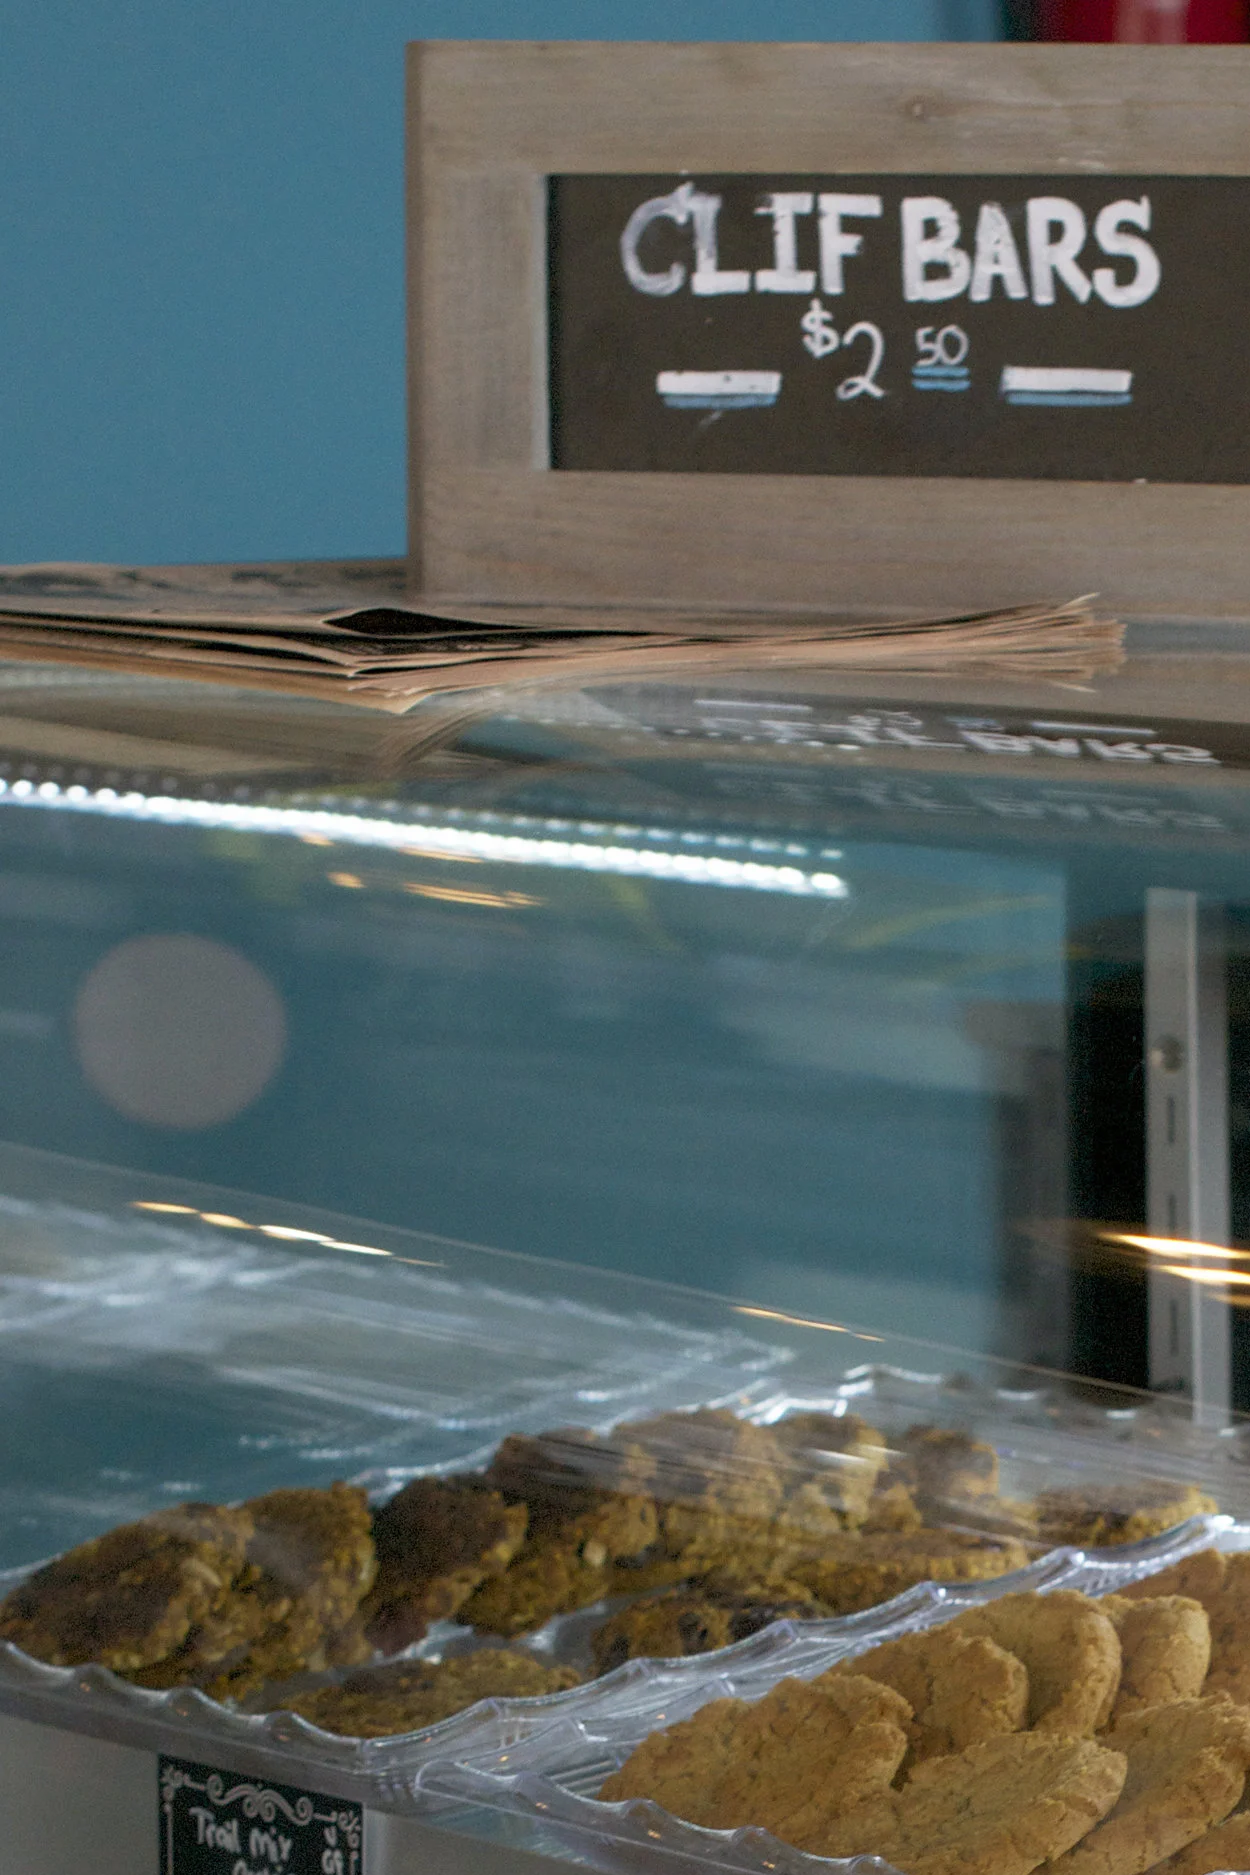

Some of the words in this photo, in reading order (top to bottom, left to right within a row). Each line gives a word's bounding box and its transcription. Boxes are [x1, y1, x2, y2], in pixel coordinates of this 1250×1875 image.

[620, 181, 883, 296] CLIF
[902, 197, 1161, 308] BARS
[915, 325, 969, 367] 50
[189, 1807, 241, 1853] Trail
[250, 1826, 292, 1864] Mix
